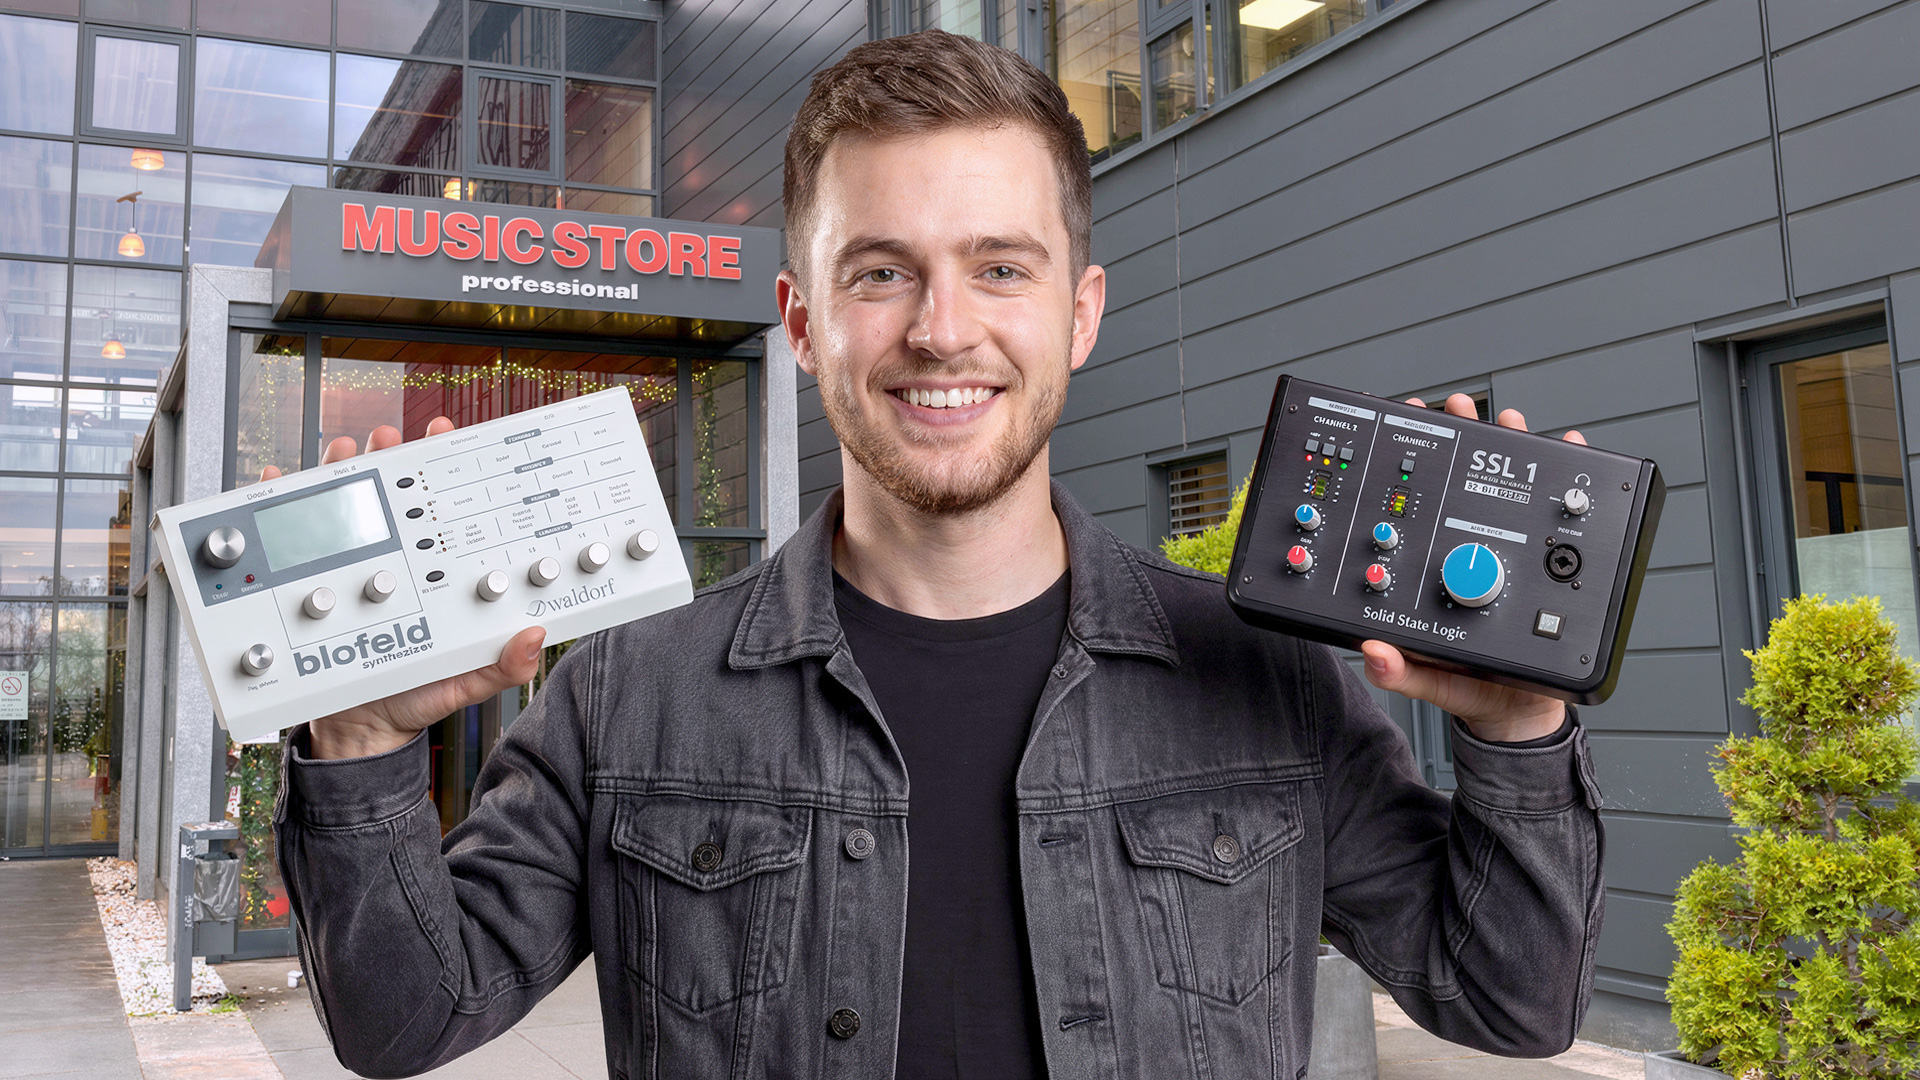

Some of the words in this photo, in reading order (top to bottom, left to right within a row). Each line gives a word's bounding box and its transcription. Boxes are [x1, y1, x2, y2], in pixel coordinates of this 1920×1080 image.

[342, 202, 545, 265] MUSIC
[551, 221, 743, 280] STORE
[462, 274, 639, 300] professional
[1470, 449, 1515, 479] SSL
[1526, 462, 1538, 483] 1
[547, 577, 616, 612] waldorf
[1363, 605, 1395, 624] Solid
[1397, 613, 1429, 632] State
[1432, 621, 1468, 642] Logic
[293, 616, 432, 677] blofeld
